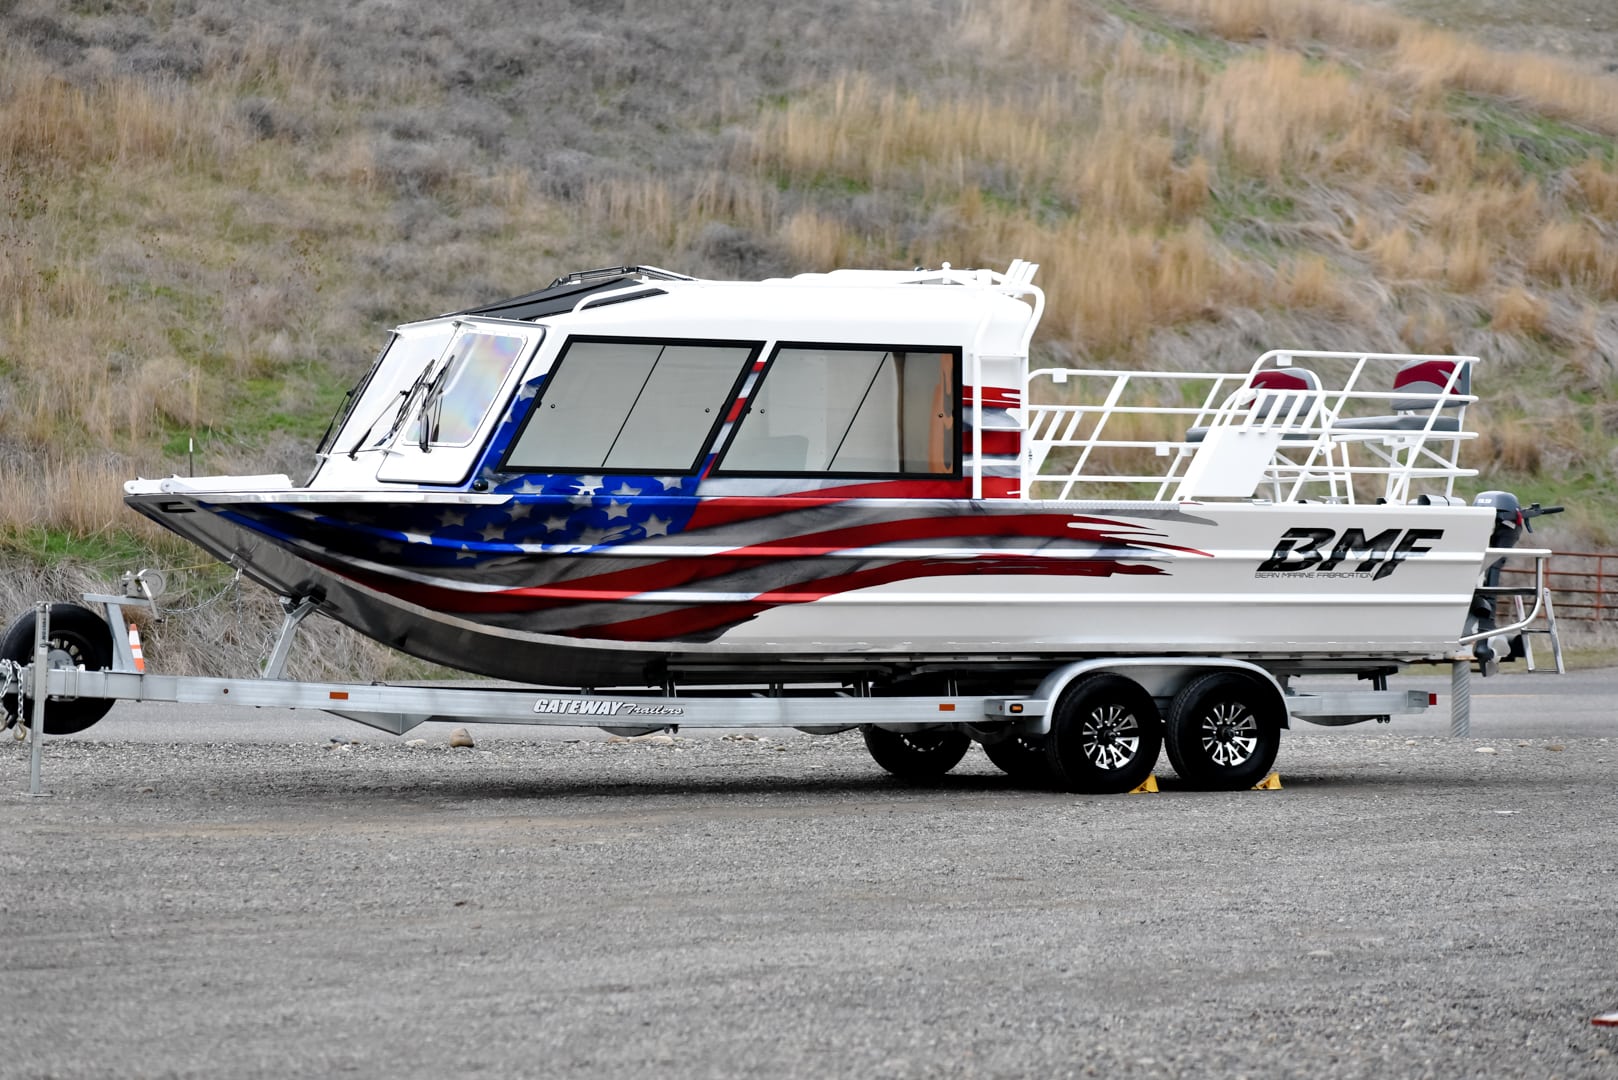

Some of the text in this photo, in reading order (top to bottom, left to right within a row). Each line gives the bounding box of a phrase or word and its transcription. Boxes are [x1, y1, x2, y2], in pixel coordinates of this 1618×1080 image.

[1256, 527, 1445, 581] BMF
[533, 698, 685, 715] GATEWAY Trailers
